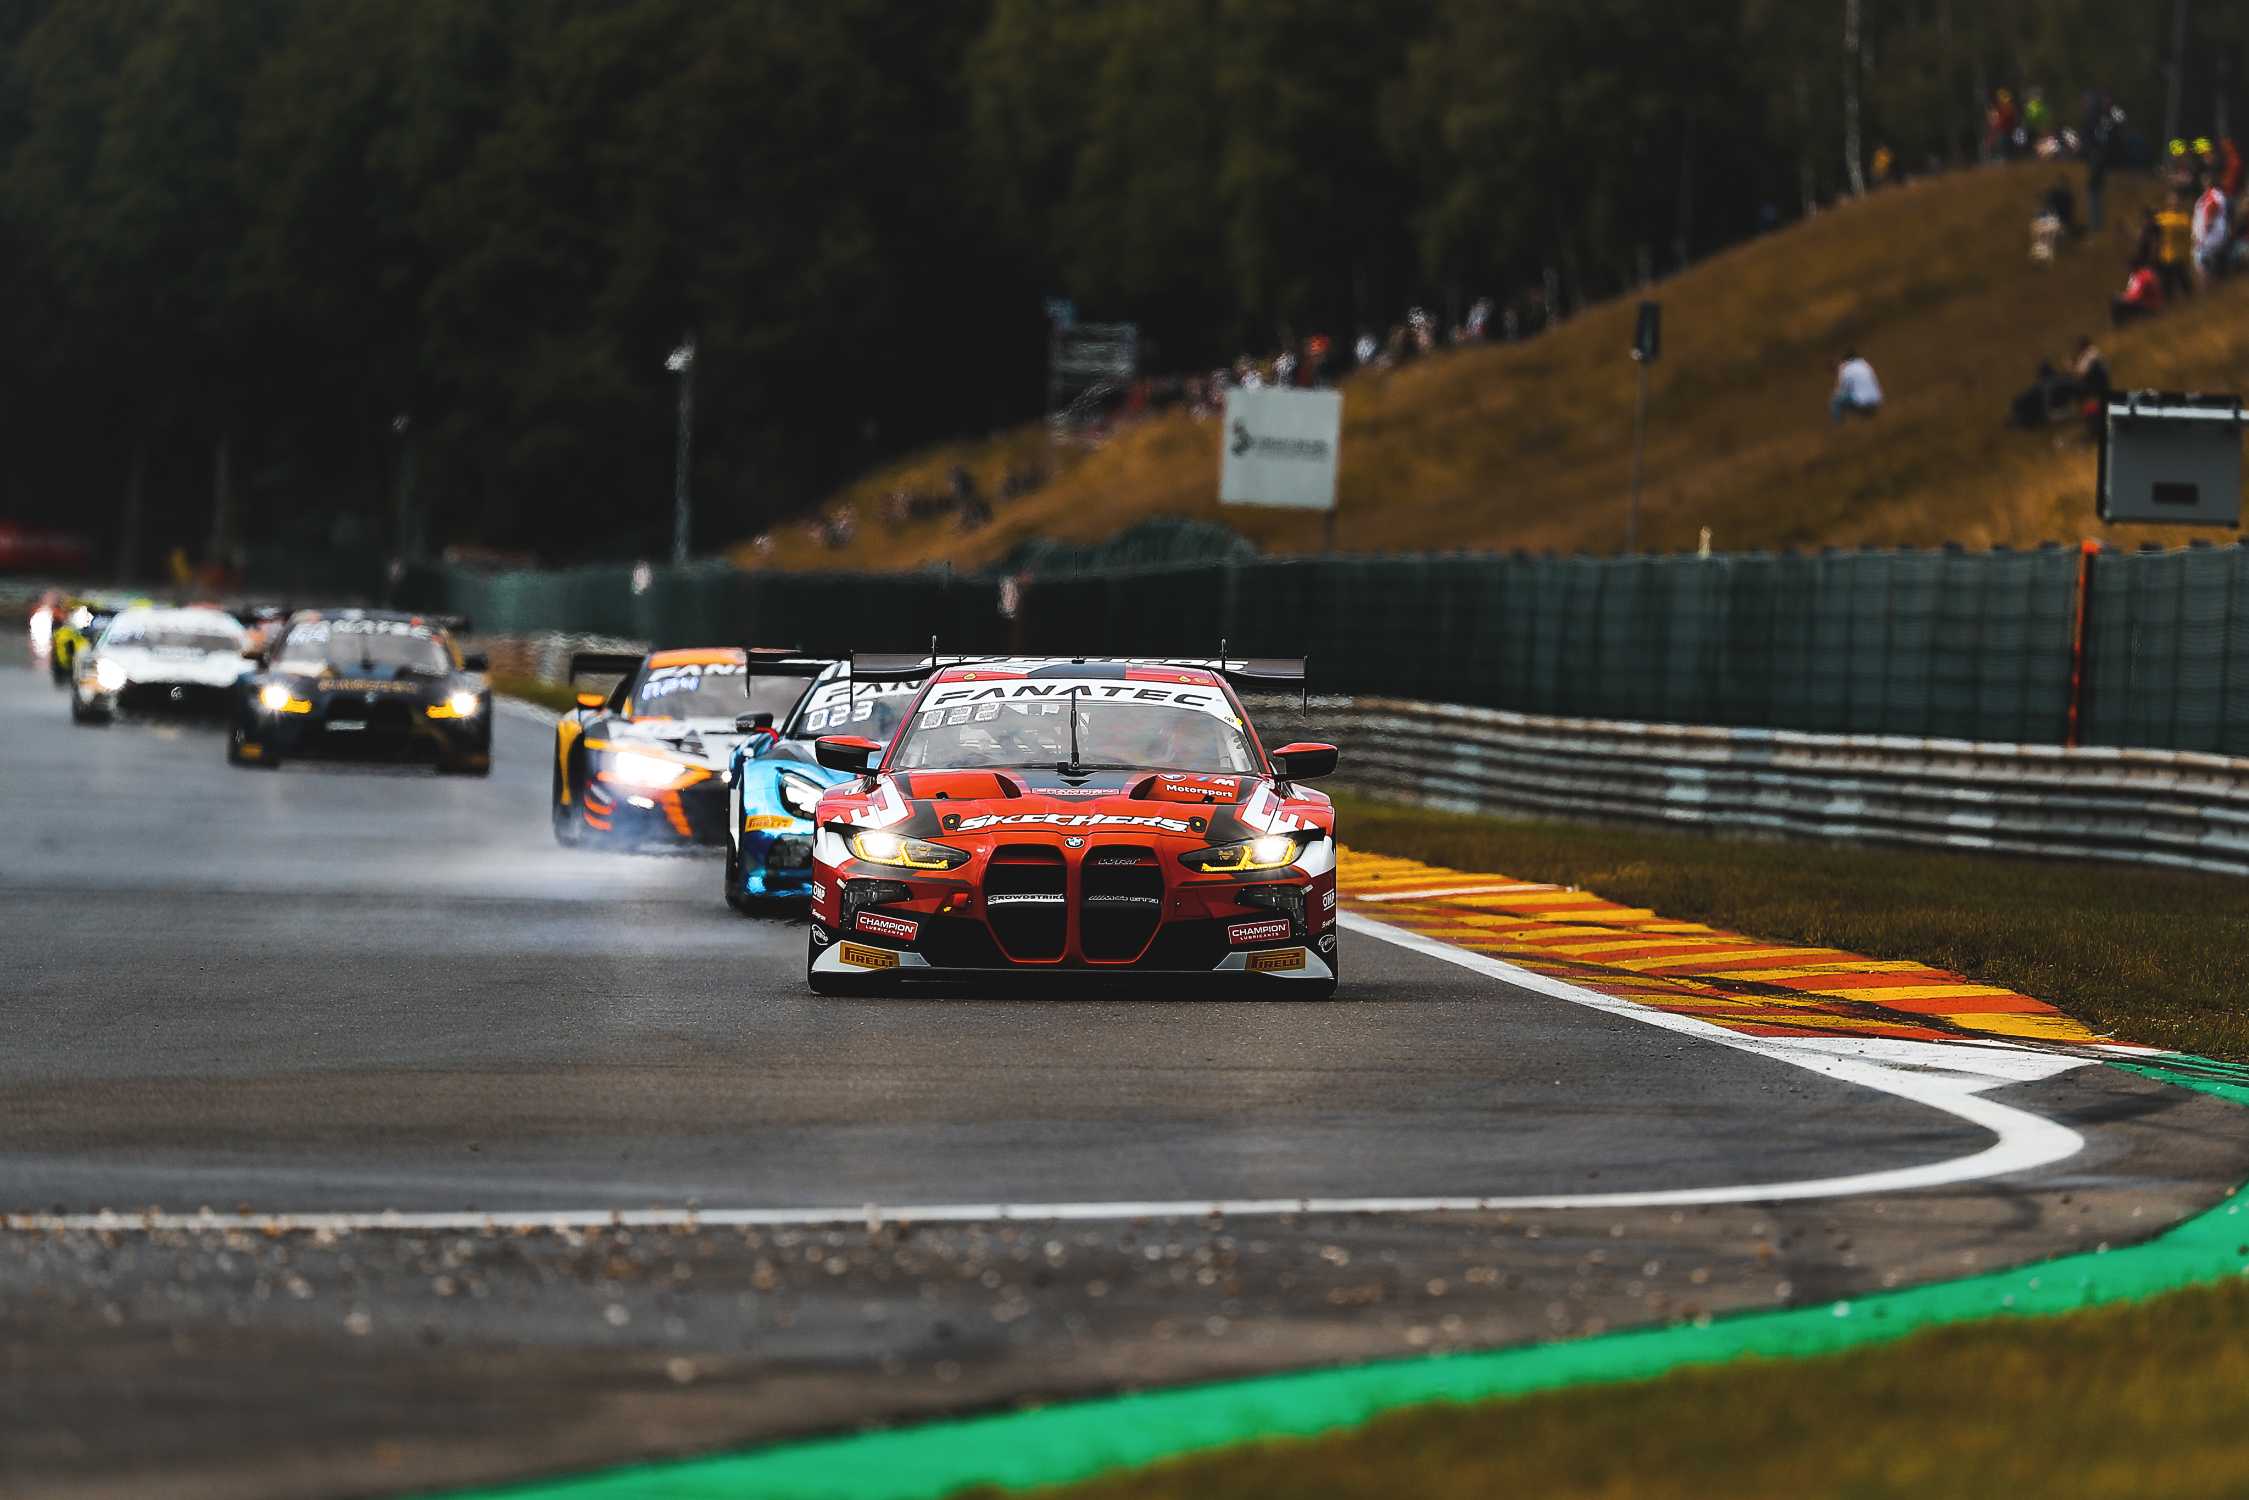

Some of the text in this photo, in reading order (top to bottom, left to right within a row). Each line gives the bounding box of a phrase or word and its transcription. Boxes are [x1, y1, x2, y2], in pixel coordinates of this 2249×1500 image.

[934, 685, 1213, 707] FANATEC
[1166, 784, 1233, 798] Motorsport
[956, 813, 1190, 833] SKECHERS
[859, 916, 913, 933] CHAMPION
[865, 925, 904, 936] LUBRICANTS
[1232, 924, 1286, 937] CHAMPION
[1240, 932, 1279, 941] LUBRICANTS
[844, 947, 894, 967] PIRELLI
[1250, 952, 1300, 969] PIRELLI
